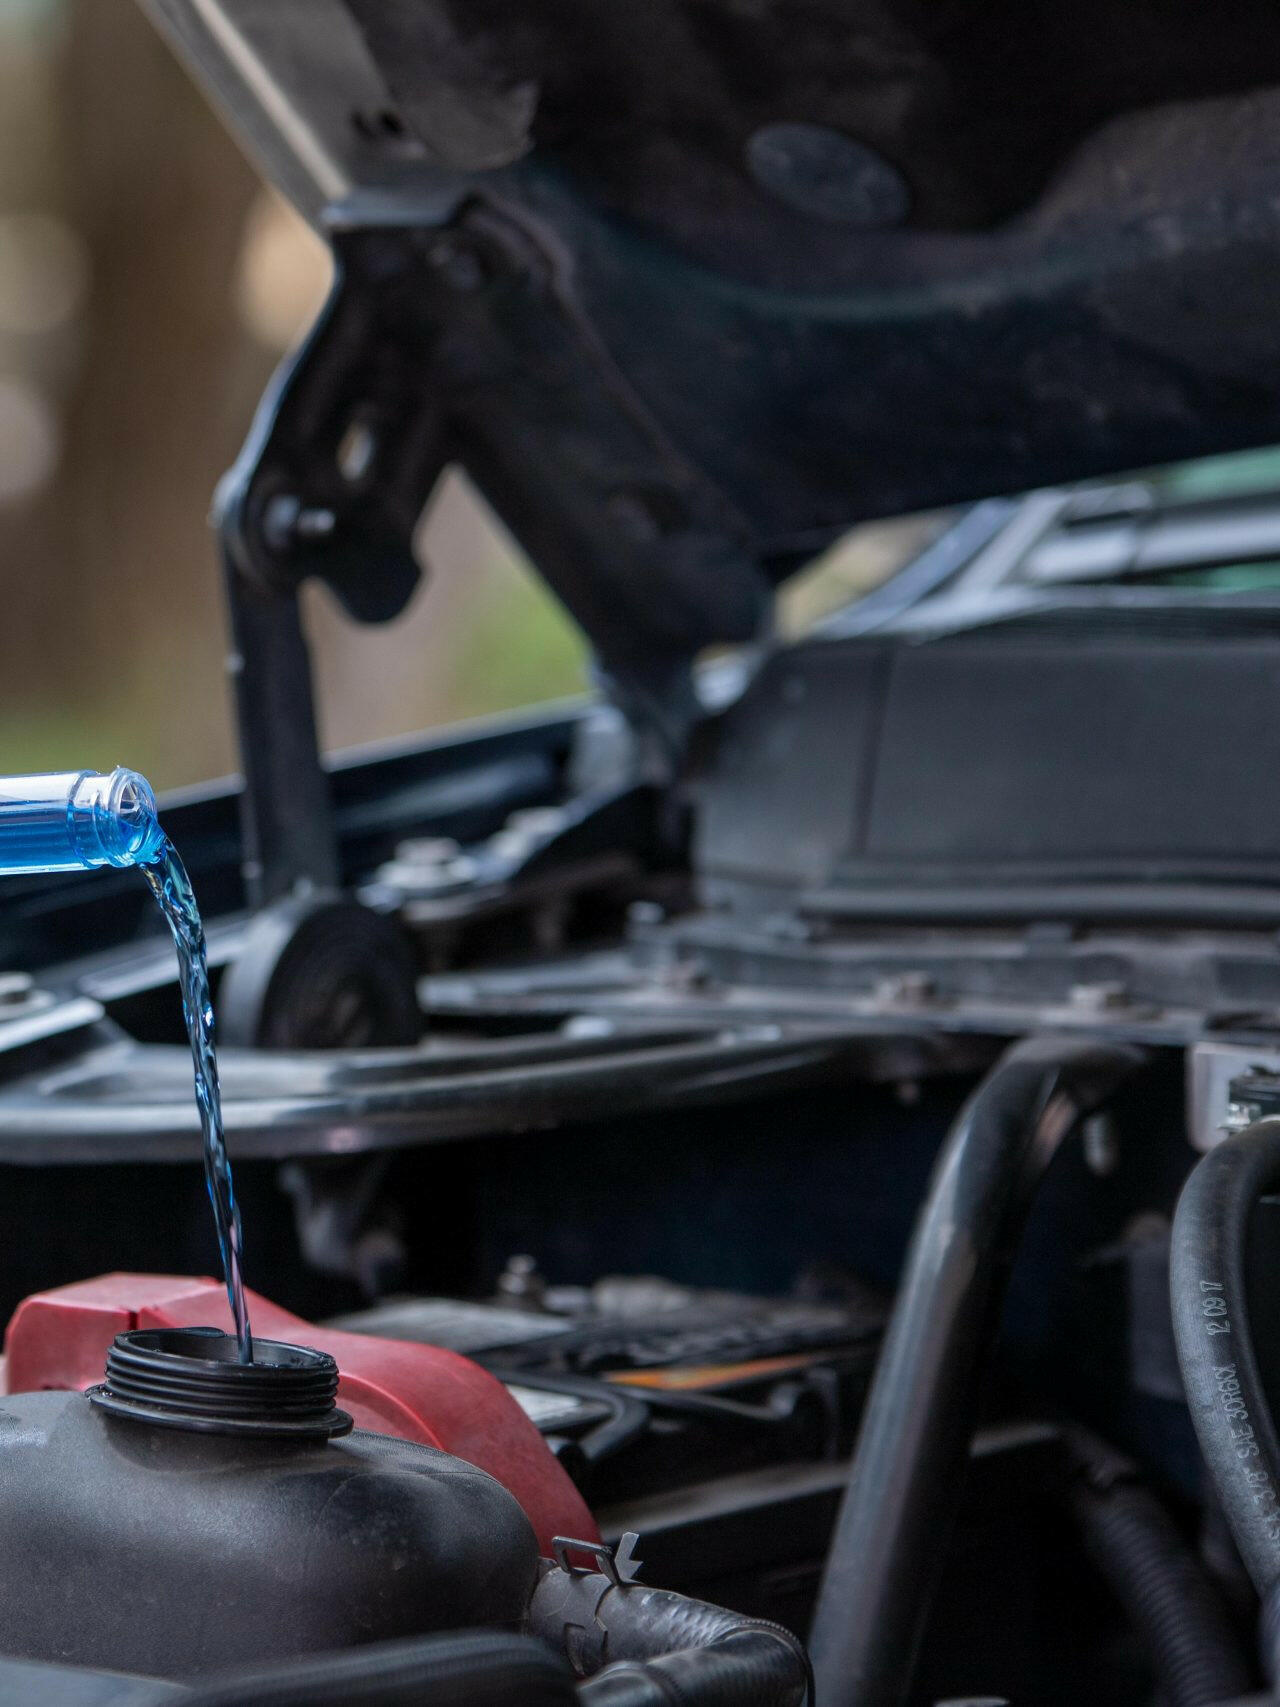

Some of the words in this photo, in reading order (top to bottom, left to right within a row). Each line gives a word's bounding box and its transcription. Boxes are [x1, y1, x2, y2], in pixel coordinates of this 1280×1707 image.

[1199, 1280, 1225, 1293] 17
[1201, 1296, 1228, 1317] 09
[1206, 1319, 1232, 1336] 12
[1230, 1421, 1261, 1460] SAE
